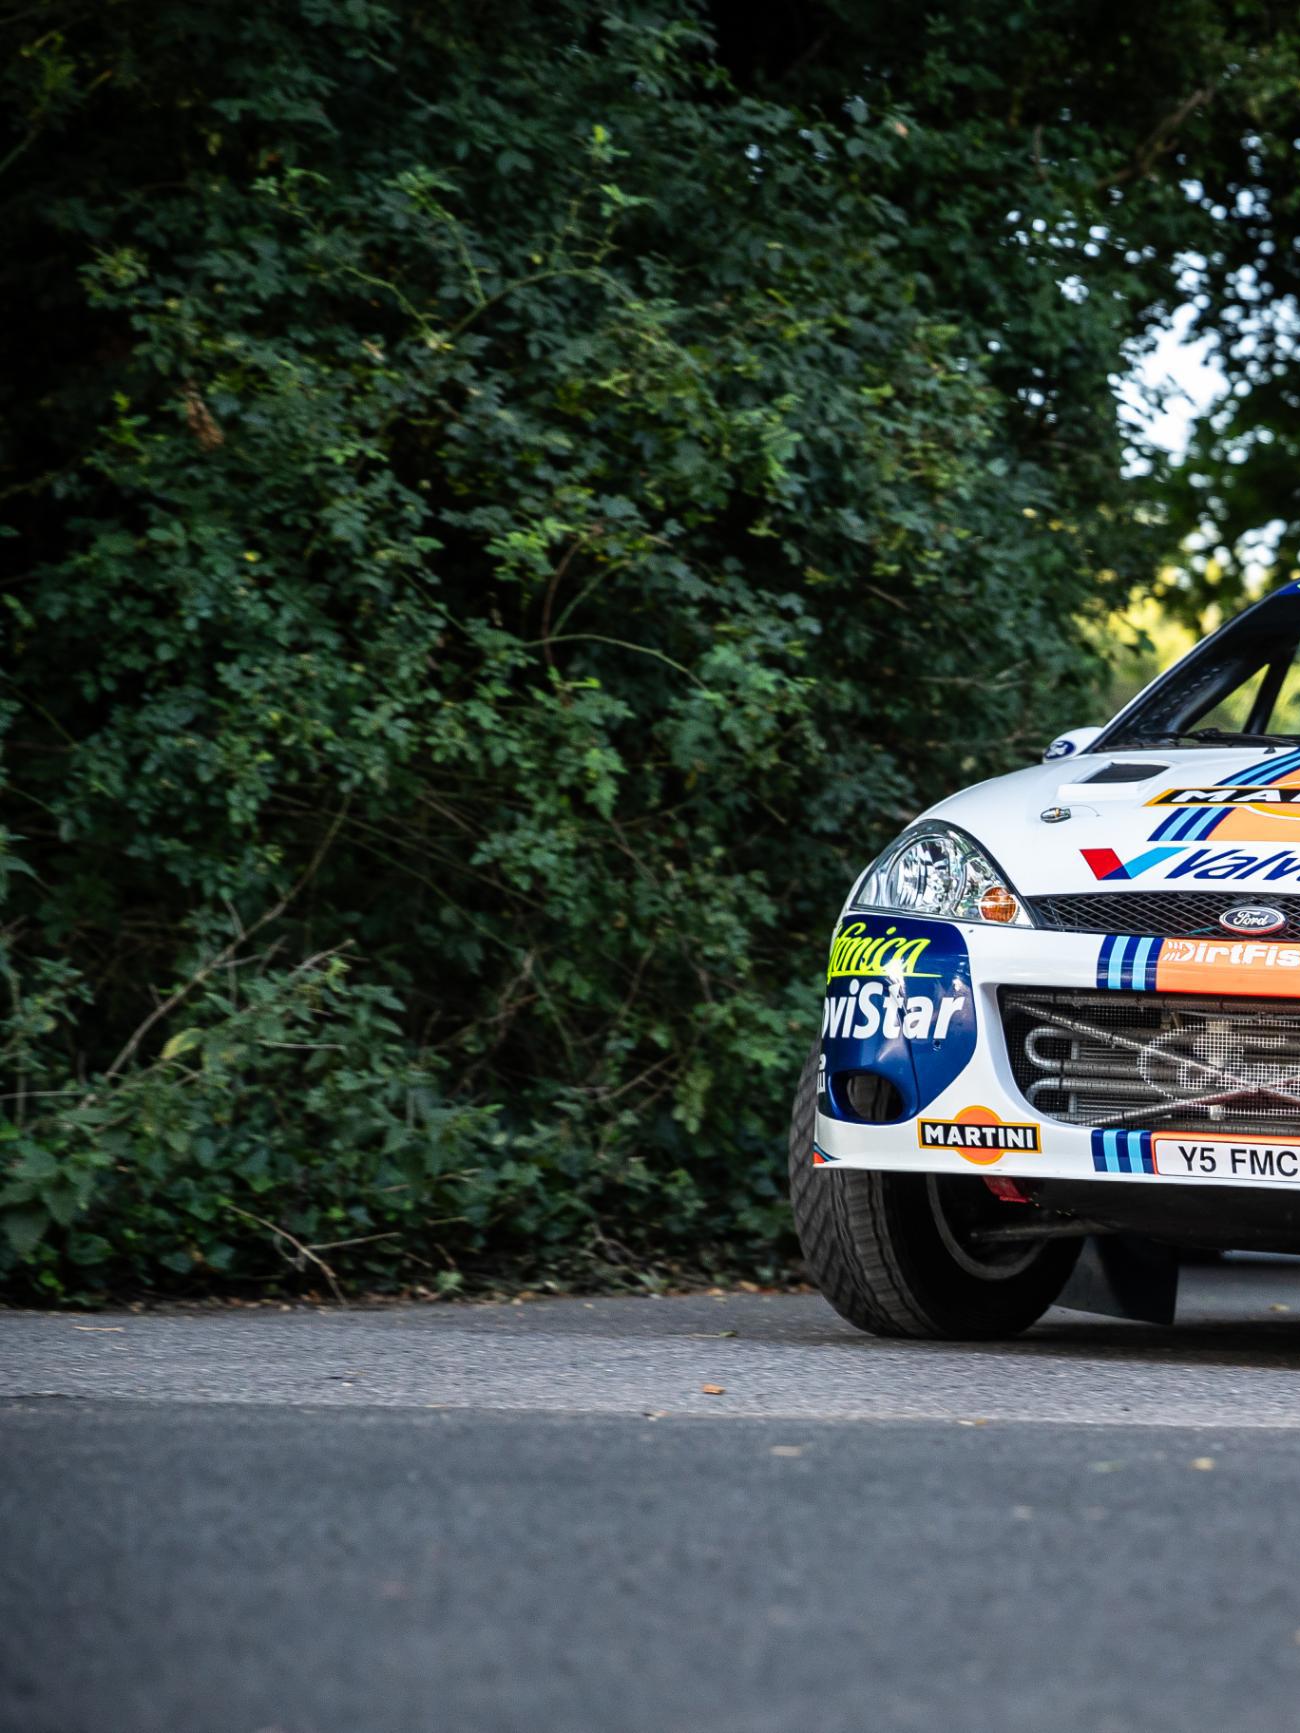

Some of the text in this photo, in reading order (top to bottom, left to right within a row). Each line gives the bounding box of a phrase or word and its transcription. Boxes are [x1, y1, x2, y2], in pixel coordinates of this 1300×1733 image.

[1233, 911, 1268, 926] Ford
[924, 1123, 1035, 1149] MARTINI
[1178, 1146, 1299, 1177] Y5 FMC
